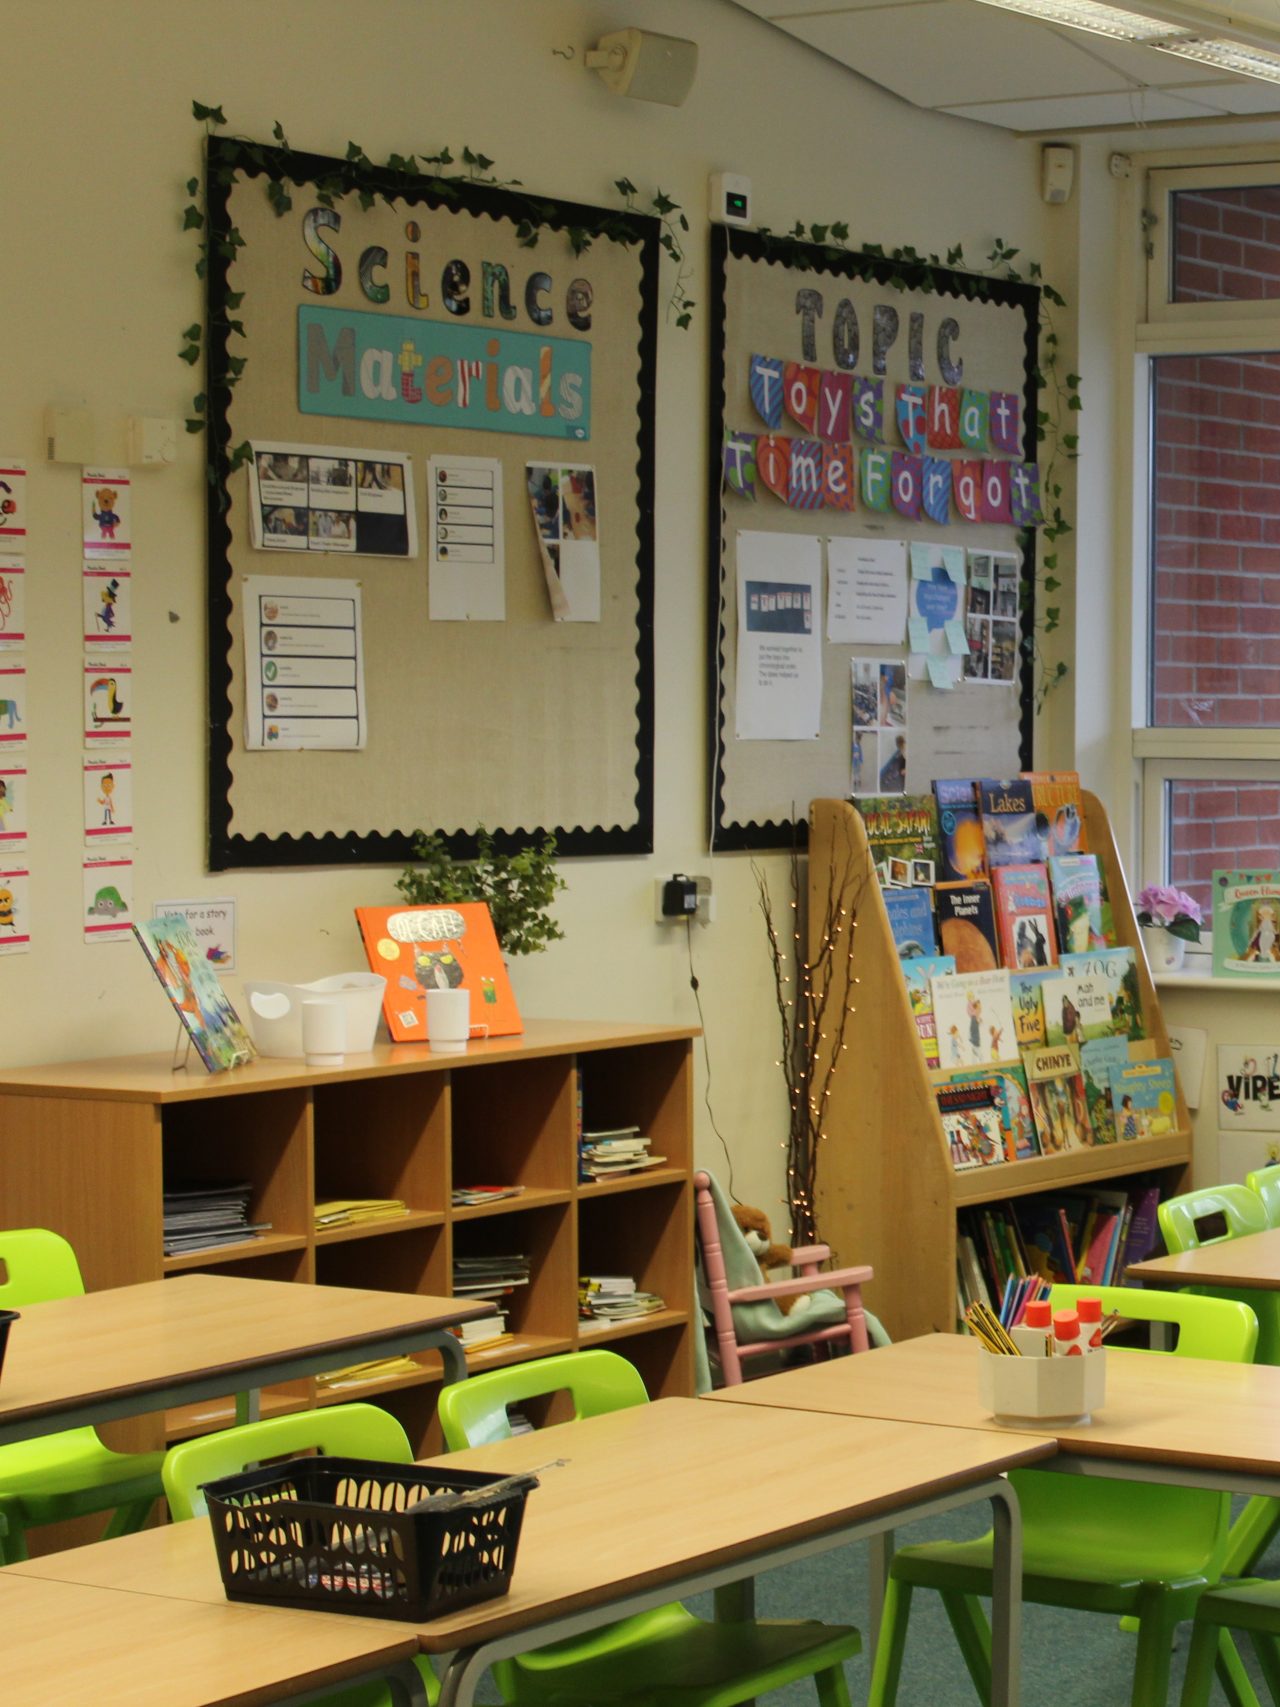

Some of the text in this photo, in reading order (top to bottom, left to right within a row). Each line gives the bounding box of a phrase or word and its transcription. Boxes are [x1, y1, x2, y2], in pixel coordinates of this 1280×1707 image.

[302, 206, 594, 332] Science
[795, 288, 964, 386] TOPIC
[306, 322, 584, 420] Materials
[754, 366, 1011, 440] Toys That
[727, 439, 1034, 520] Time Forgot
[988, 793, 1025, 813] Lakes
[950, 895, 962, 905] The
[185, 909, 198, 919] for
[199, 911, 205, 919] a
[206, 909, 227, 921] story
[954, 904, 979, 917] Planets
[195, 926, 215, 937] book
[1020, 982, 1032, 994] The
[1018, 995, 1038, 1016] Ugly
[1018, 1015, 1040, 1034] Five
[1035, 1053, 1072, 1072] CHINYE
